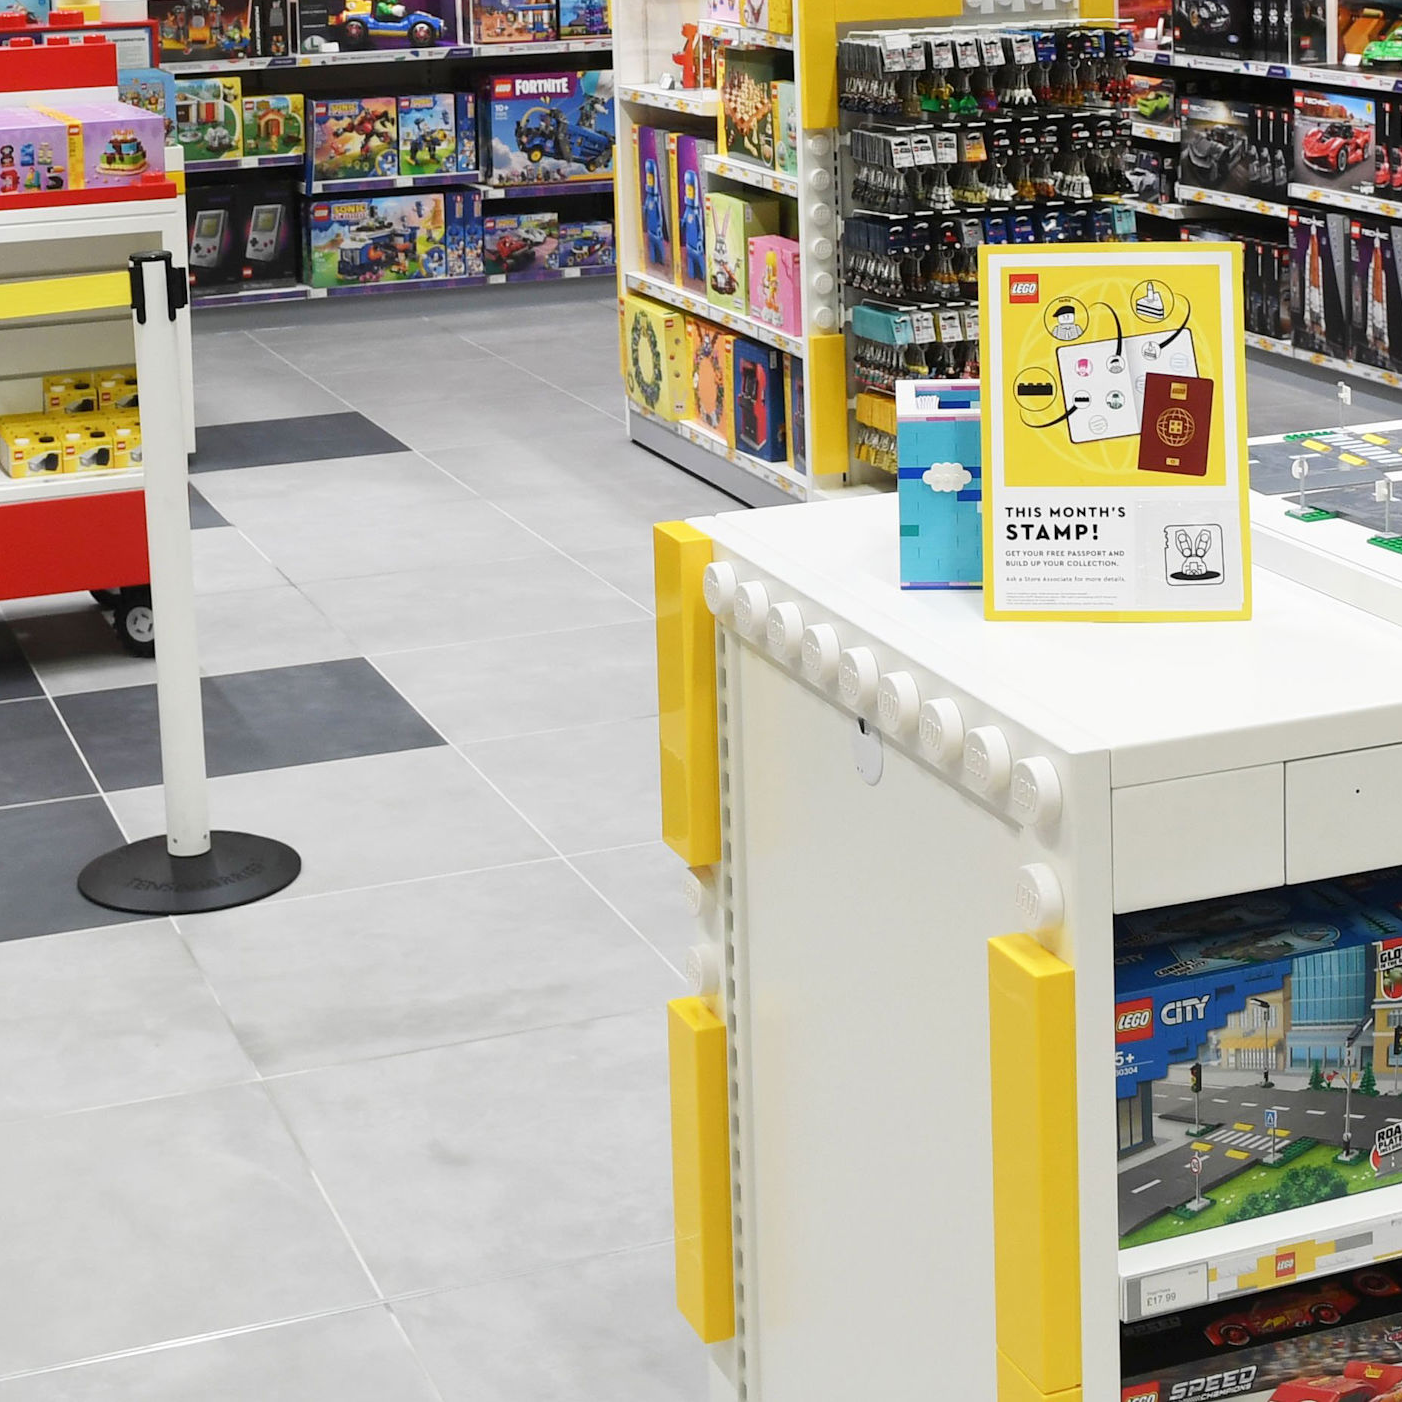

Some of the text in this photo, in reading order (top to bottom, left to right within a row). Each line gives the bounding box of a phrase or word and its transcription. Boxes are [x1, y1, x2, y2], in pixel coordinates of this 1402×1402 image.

[515, 77, 570, 96] FORTNITE
[1010, 282, 1037, 295] LEGO
[1005, 506, 1126, 518] THIS MONTH'S
[1006, 524, 1099, 541] STAMP!
[1116, 994, 1211, 1030] LEGO CITY
[1115, 1052, 1134, 1067] 5+
[1168, 1365, 1258, 1402] SPEED
